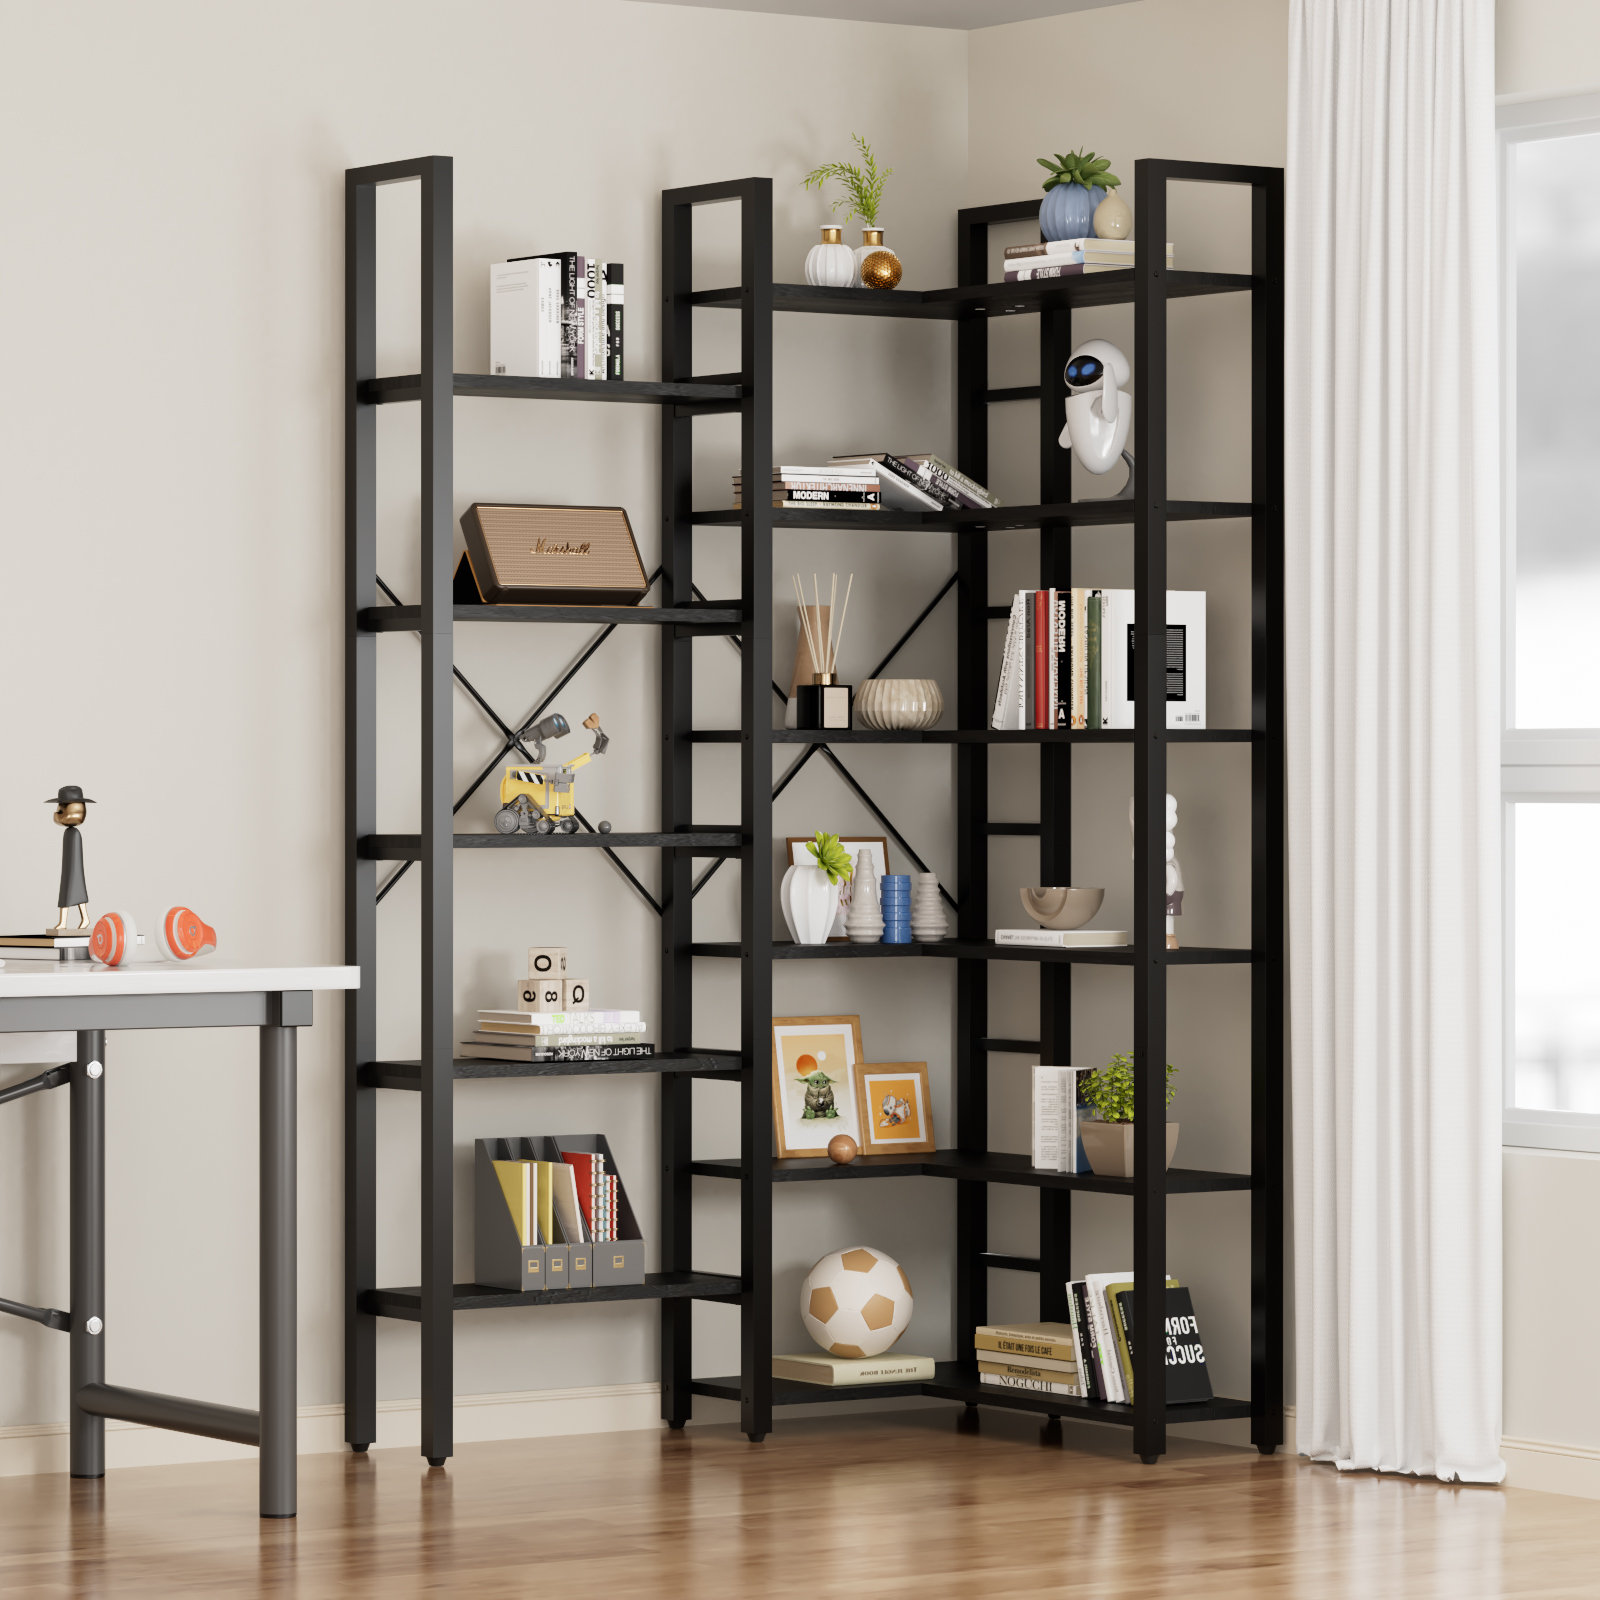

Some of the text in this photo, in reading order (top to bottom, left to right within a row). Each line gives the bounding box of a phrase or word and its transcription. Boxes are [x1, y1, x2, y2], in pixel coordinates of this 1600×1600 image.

[587, 264, 595, 298] 1000
[569, 297, 575, 308] OF
[886, 457, 899, 467] THE
[926, 462, 950, 481] 1000
[793, 491, 829, 500] MODERN
[601, 1048, 612, 1056] OF
[613, 1047, 635, 1056] LIGHT
[636, 1047, 652, 1055] THE
[998, 1341, 1052, 1356] IL ÉTAIT UNE FOIS LE CAFÉ
[999, 1375, 1052, 1391] NOGUCHI
